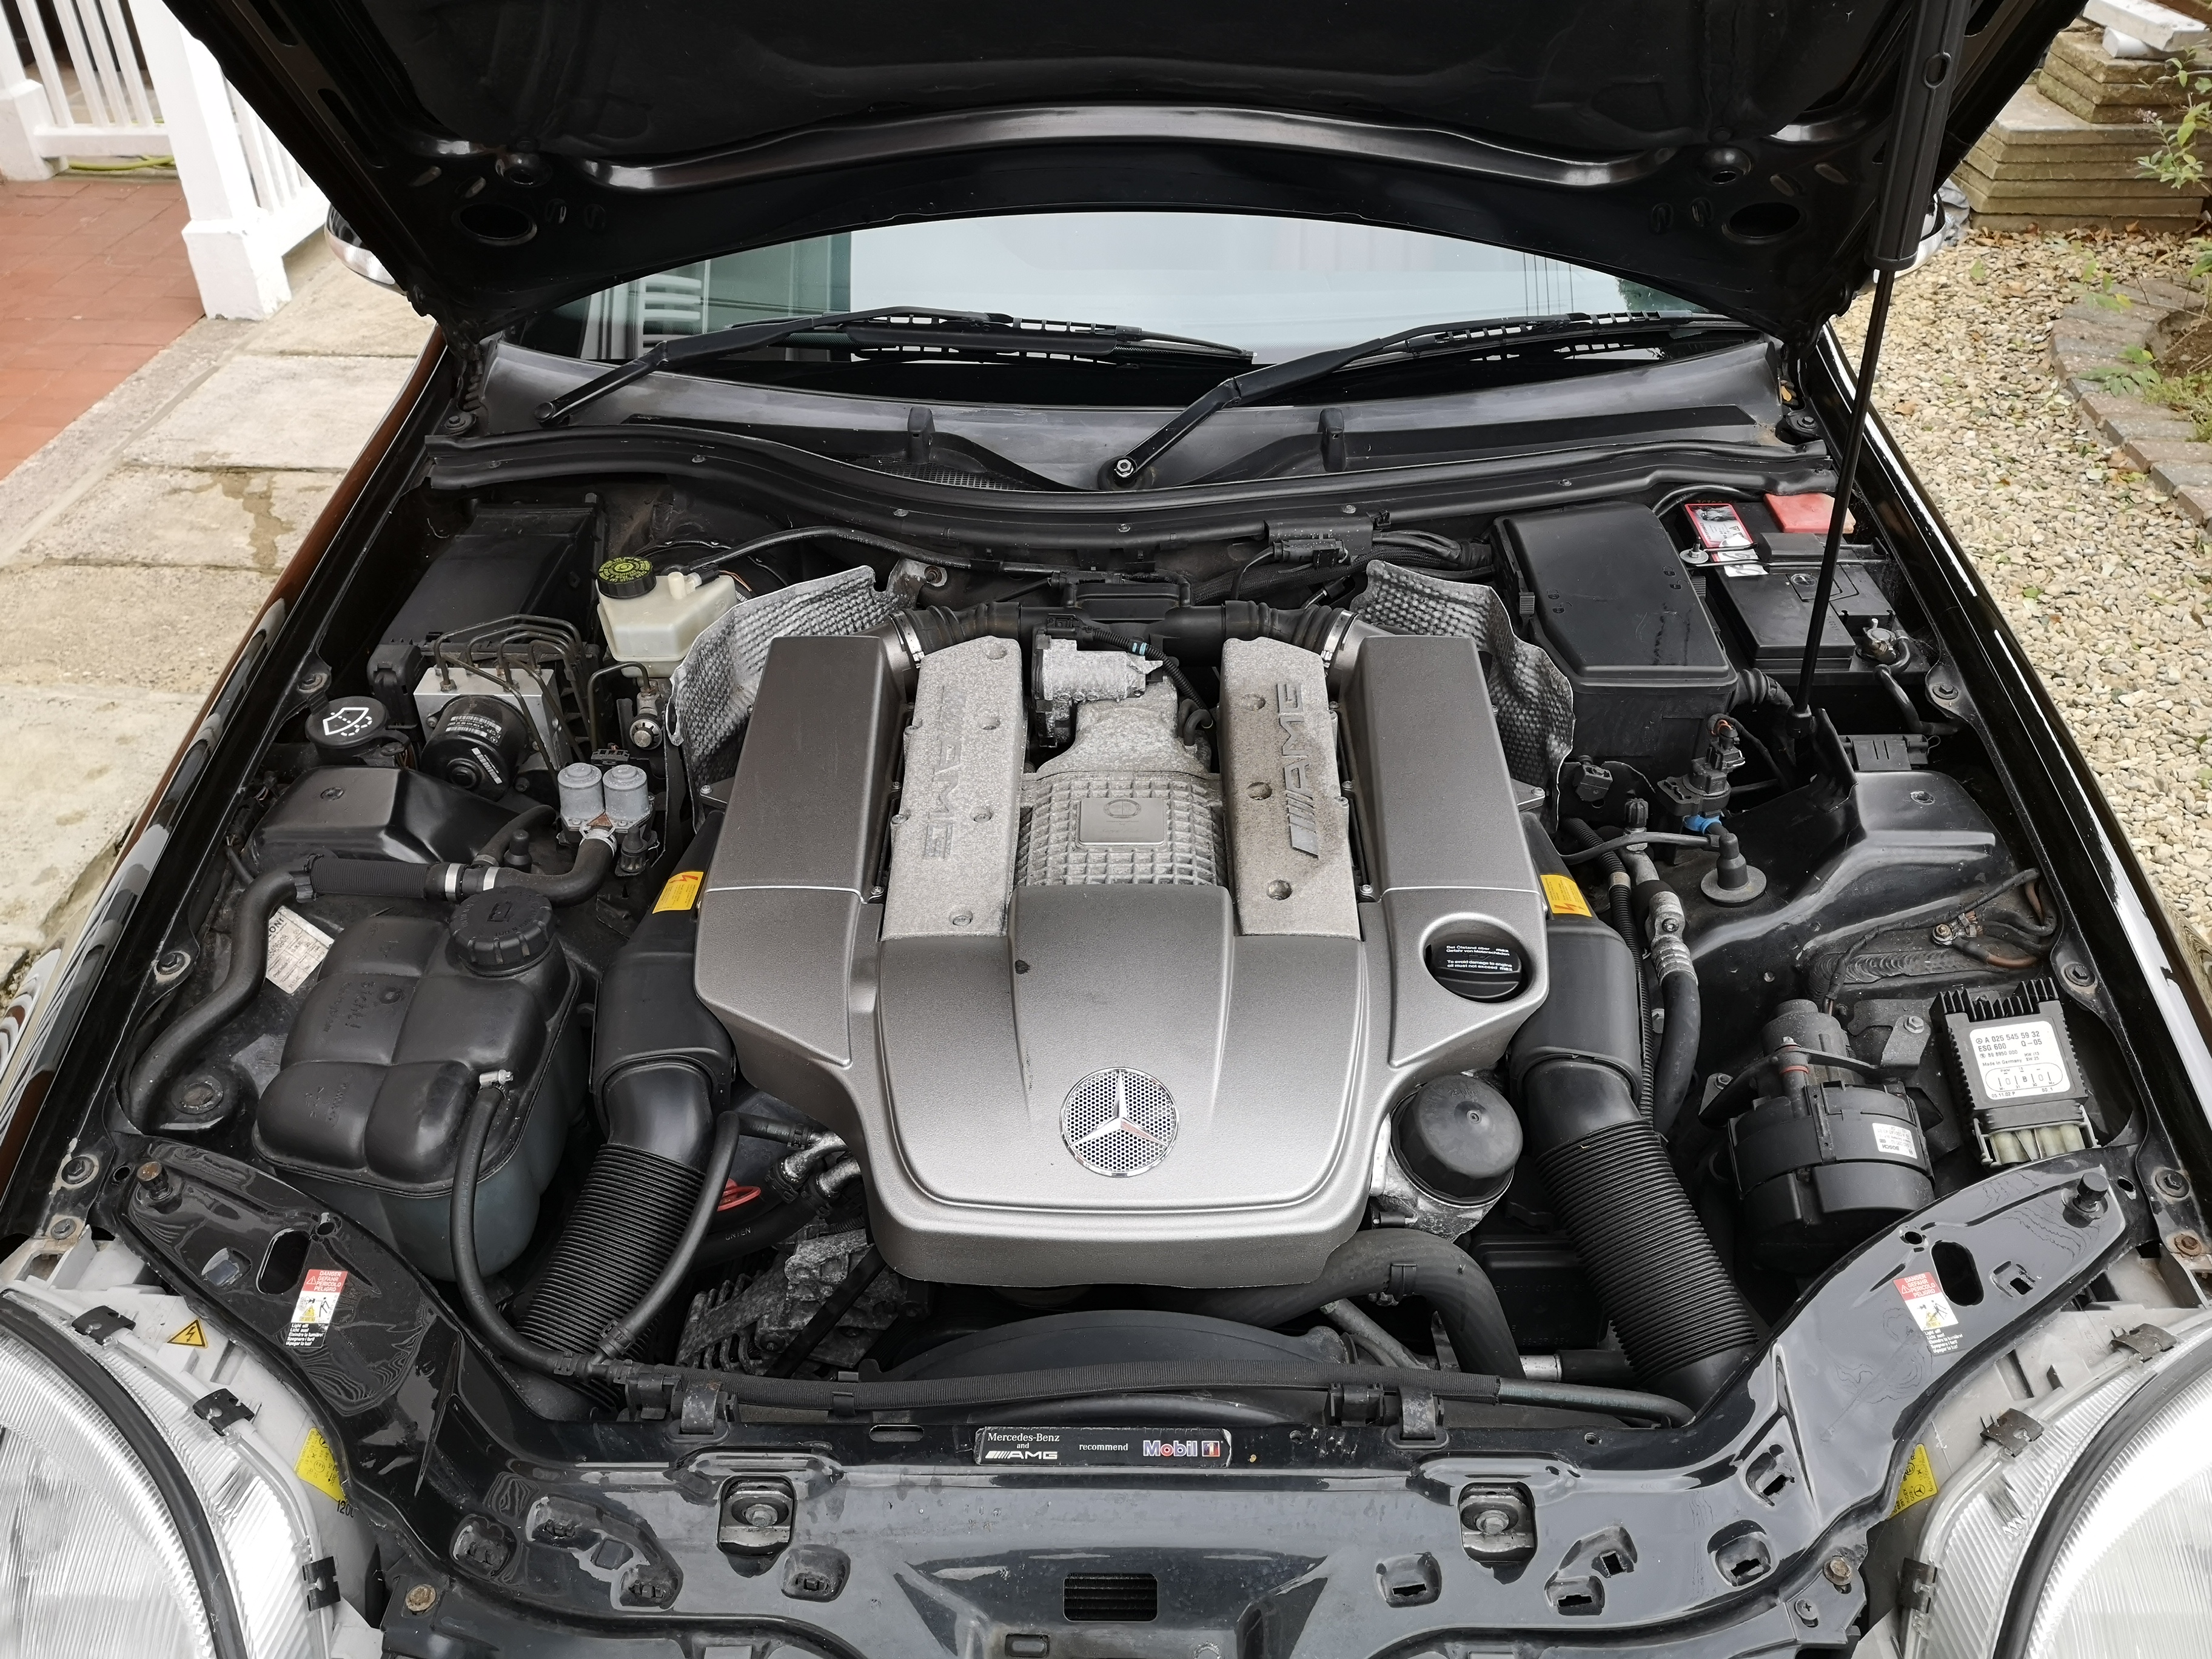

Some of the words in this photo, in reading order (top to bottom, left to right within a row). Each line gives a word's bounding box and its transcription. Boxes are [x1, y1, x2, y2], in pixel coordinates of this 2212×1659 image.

[1277, 683, 1312, 794] AMG
[269, 917, 284, 937] ONI
[1905, 1274, 1926, 1283] DANGER
[1908, 1279, 1928, 1287] GEFAHR
[1910, 1283, 1936, 1293] PERICOLO
[1913, 1289, 1936, 1298] PELIGRO
[987, 1432, 1060, 1442] Mercedes-Benz
[1143, 1440, 1198, 1456] Mobil
[1007, 1451, 1057, 1460] AMG
